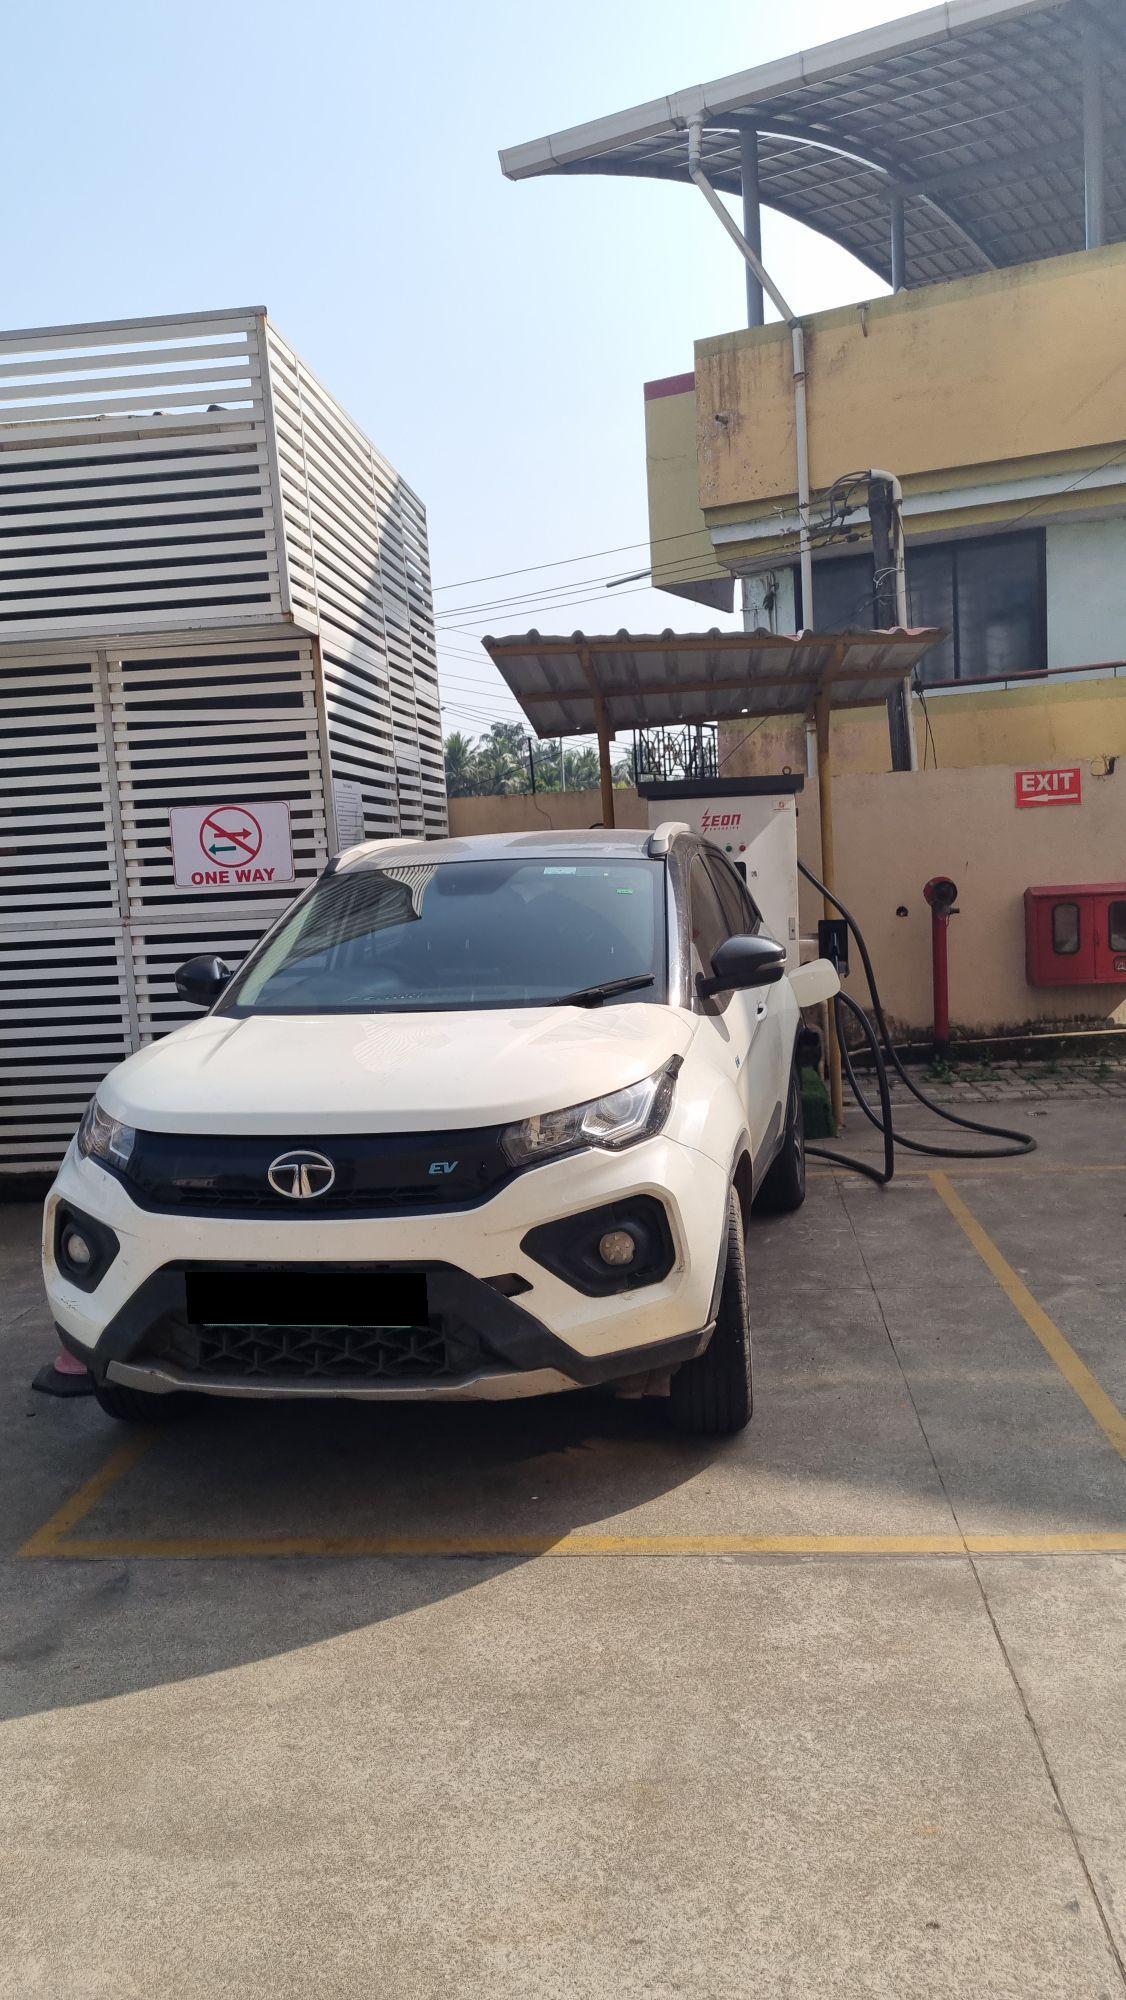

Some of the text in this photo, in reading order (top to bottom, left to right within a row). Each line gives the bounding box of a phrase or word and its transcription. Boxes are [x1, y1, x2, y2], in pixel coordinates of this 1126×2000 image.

[1022, 772, 1074, 792] EXIT
[701, 809, 742, 831] ZEON
[191, 867, 275, 885] ONE WAY
[429, 1161, 459, 1174] EV
